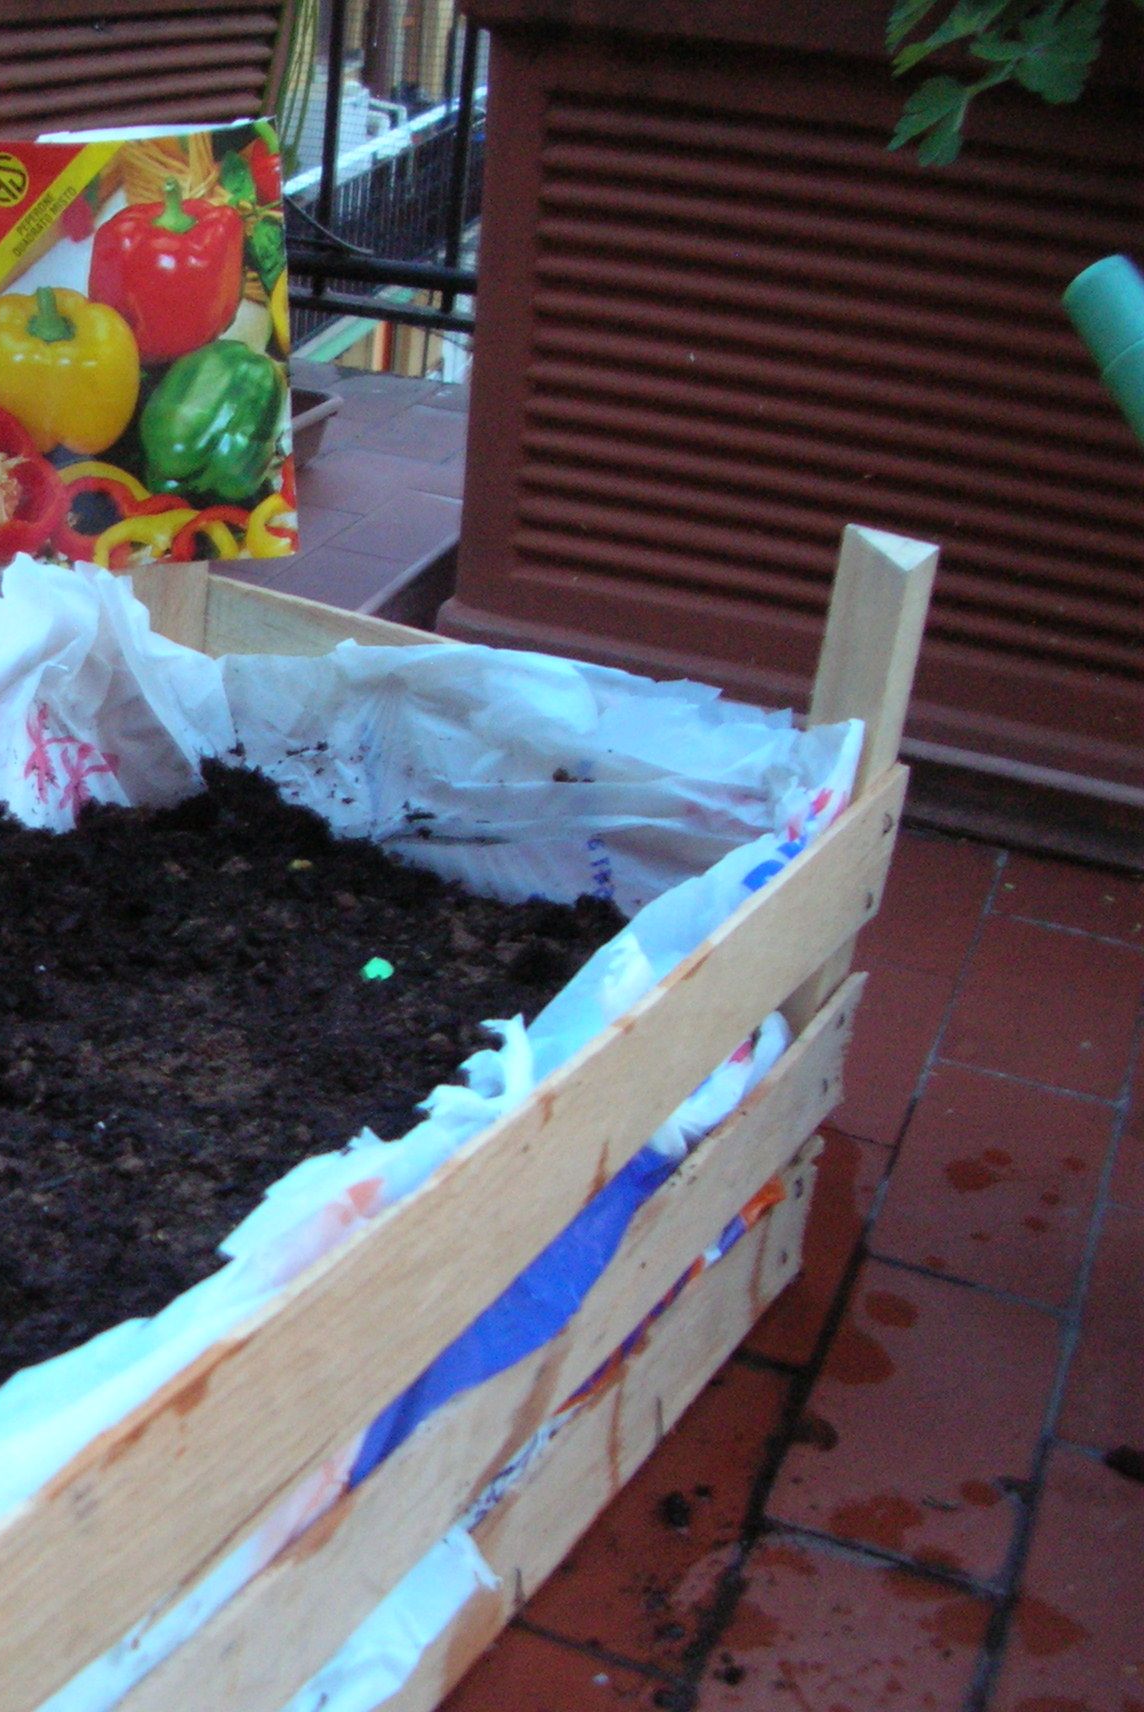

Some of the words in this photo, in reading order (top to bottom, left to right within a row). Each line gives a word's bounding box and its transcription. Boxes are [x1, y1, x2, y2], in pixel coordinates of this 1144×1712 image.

[12, 213, 54, 258] QUADRATO
[50, 186, 77, 215] MISTO
[15, 193, 54, 236] PEPERONE
